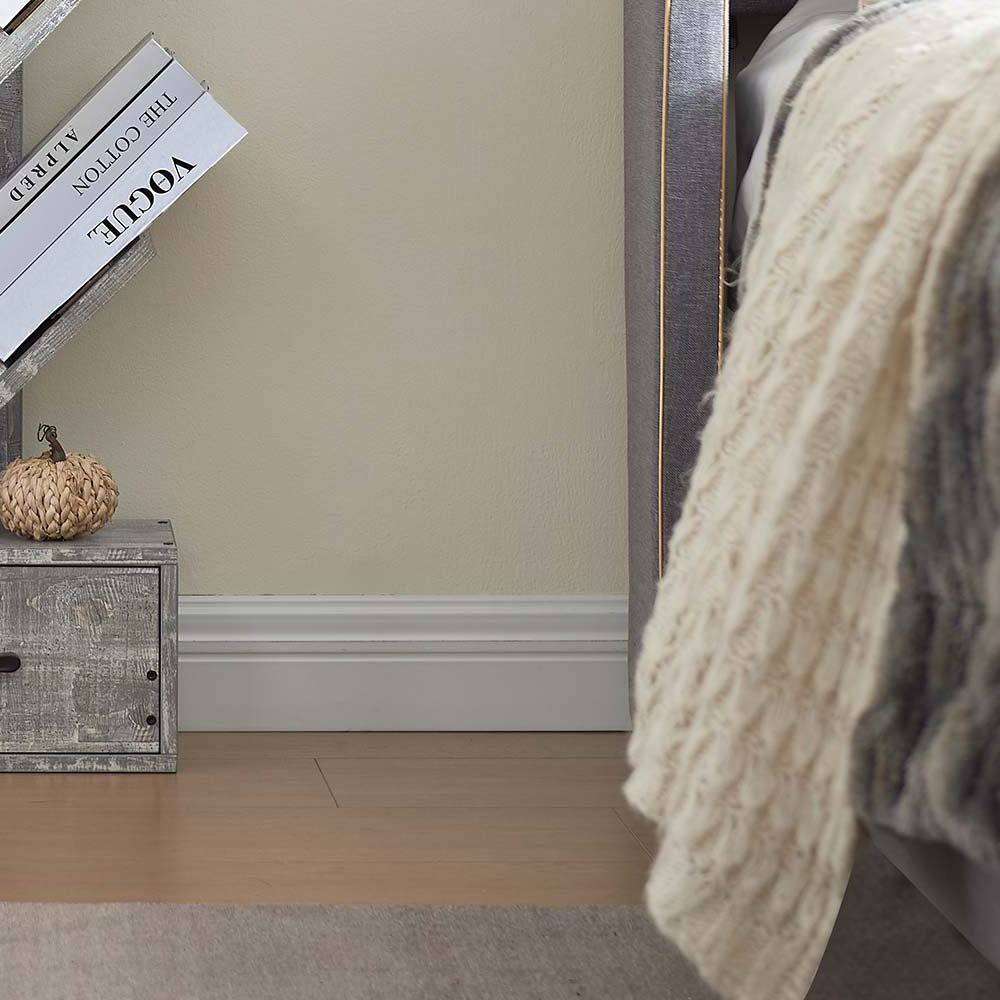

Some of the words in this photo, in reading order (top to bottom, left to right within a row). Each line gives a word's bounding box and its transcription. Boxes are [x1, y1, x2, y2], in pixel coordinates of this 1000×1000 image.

[138, 91, 179, 129] THE
[8, 126, 80, 203] ALPRED
[71, 125, 141, 197] COTTON
